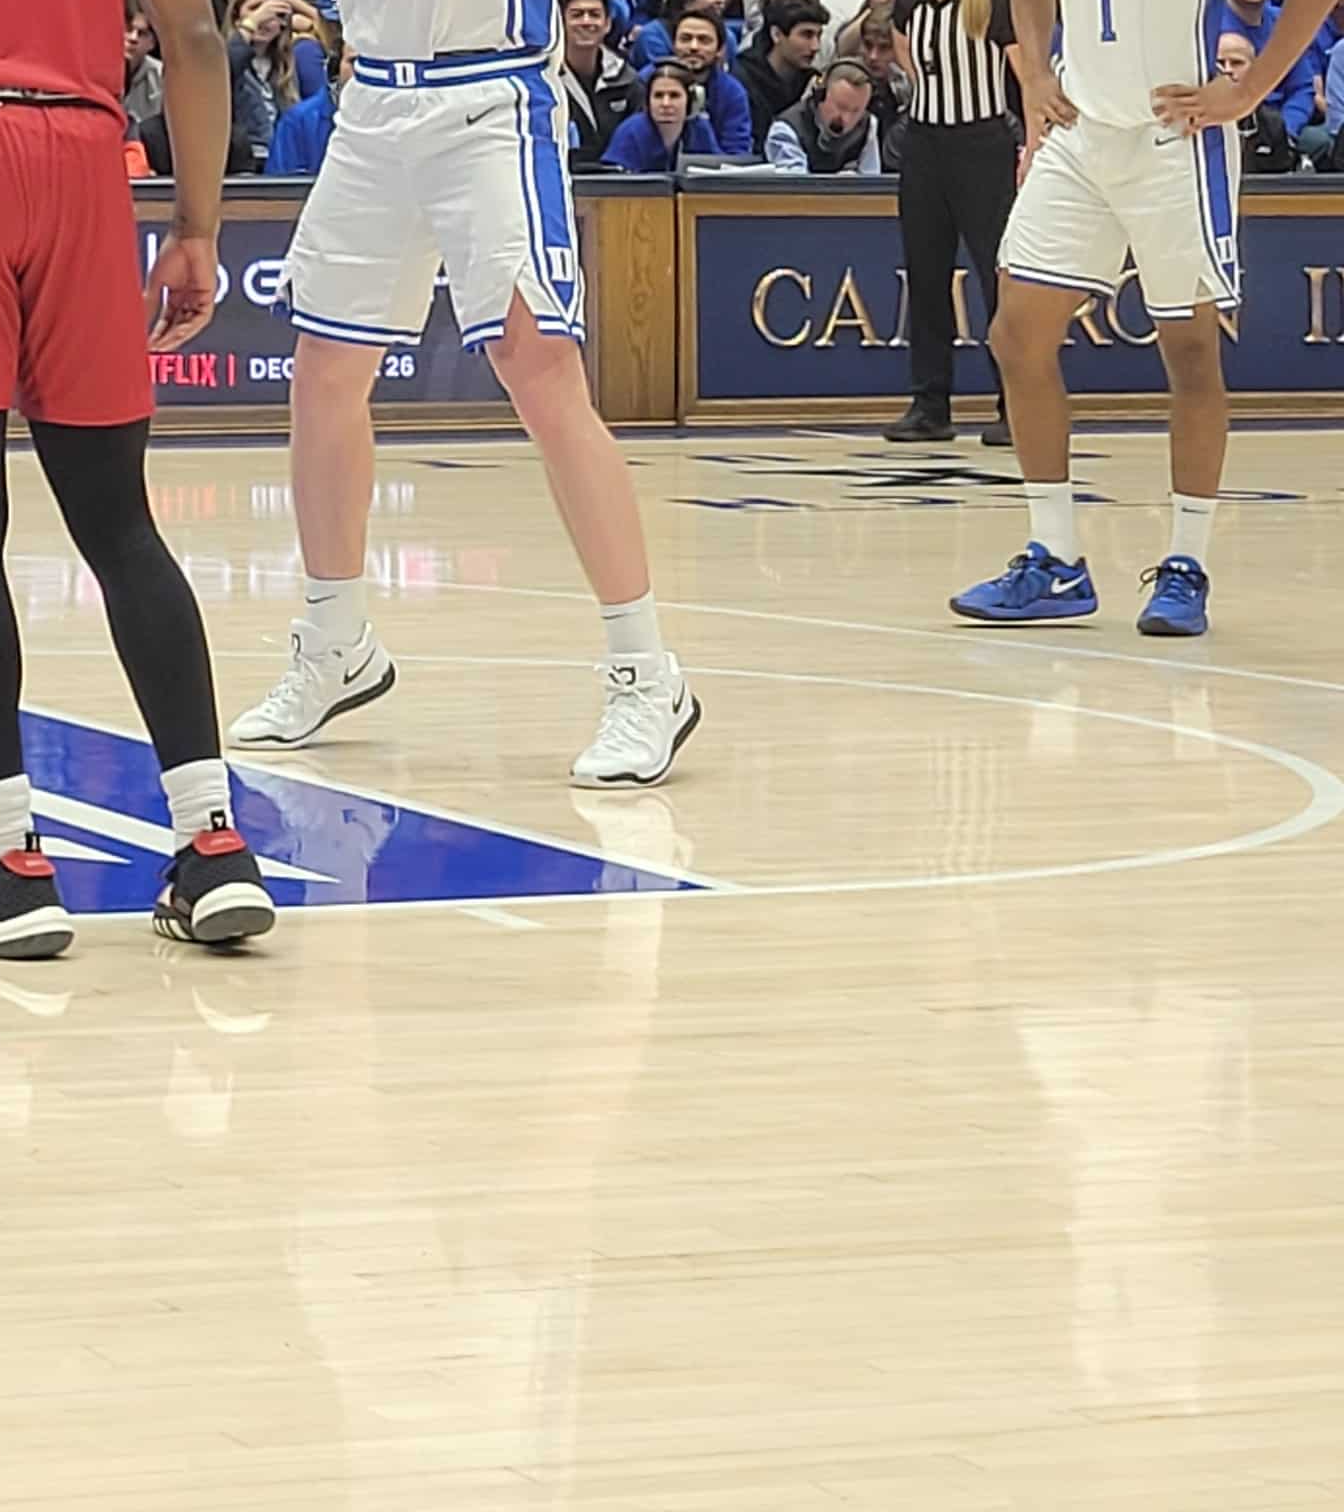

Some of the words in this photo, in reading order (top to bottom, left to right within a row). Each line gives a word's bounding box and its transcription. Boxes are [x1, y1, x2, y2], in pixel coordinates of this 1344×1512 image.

[393, 62, 417, 88] D
[150, 354, 218, 386] TFLIX
[385, 355, 416, 378] 26
